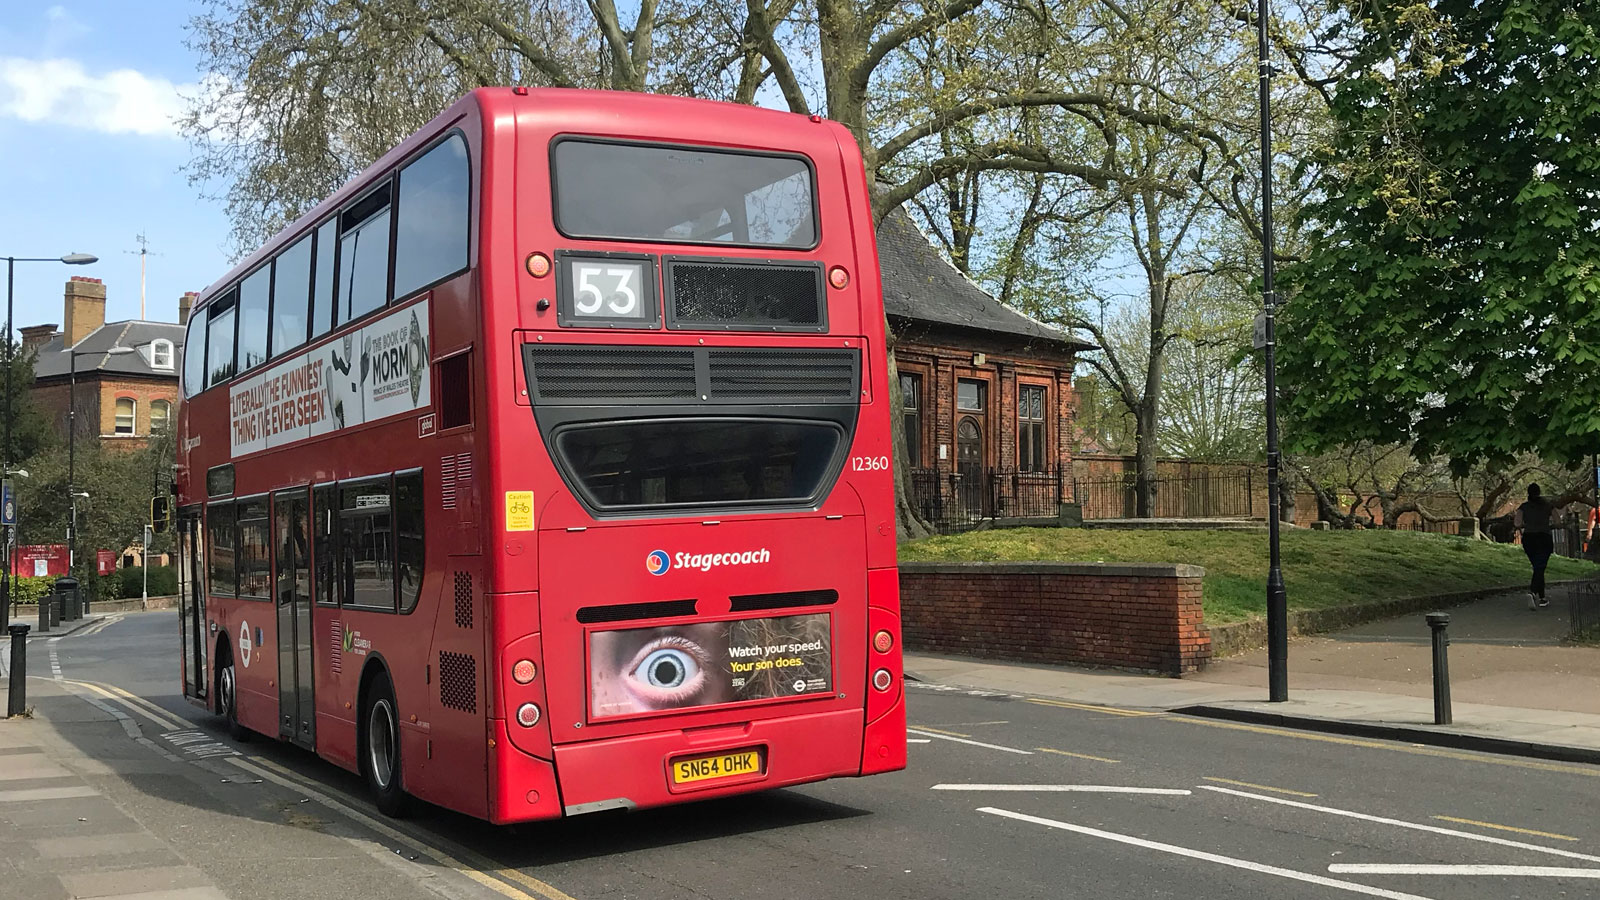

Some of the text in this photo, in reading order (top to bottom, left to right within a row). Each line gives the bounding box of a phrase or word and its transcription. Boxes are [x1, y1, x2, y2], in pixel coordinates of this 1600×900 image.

[576, 268, 636, 315] 53
[372, 326, 408, 353] THE BOOK OF
[372, 334, 430, 386] MORMON
[265, 376, 280, 406] THE
[281, 359, 323, 399] FUNNIEST
[233, 413, 256, 446] THING
[271, 399, 296, 434] EVER
[852, 456, 889, 471] 12360
[673, 548, 770, 572] Stagecoach
[728, 640, 823, 658] Watch your speed.
[730, 657, 804, 673] Your son does.
[680, 754, 752, 778] SN64 OHK
